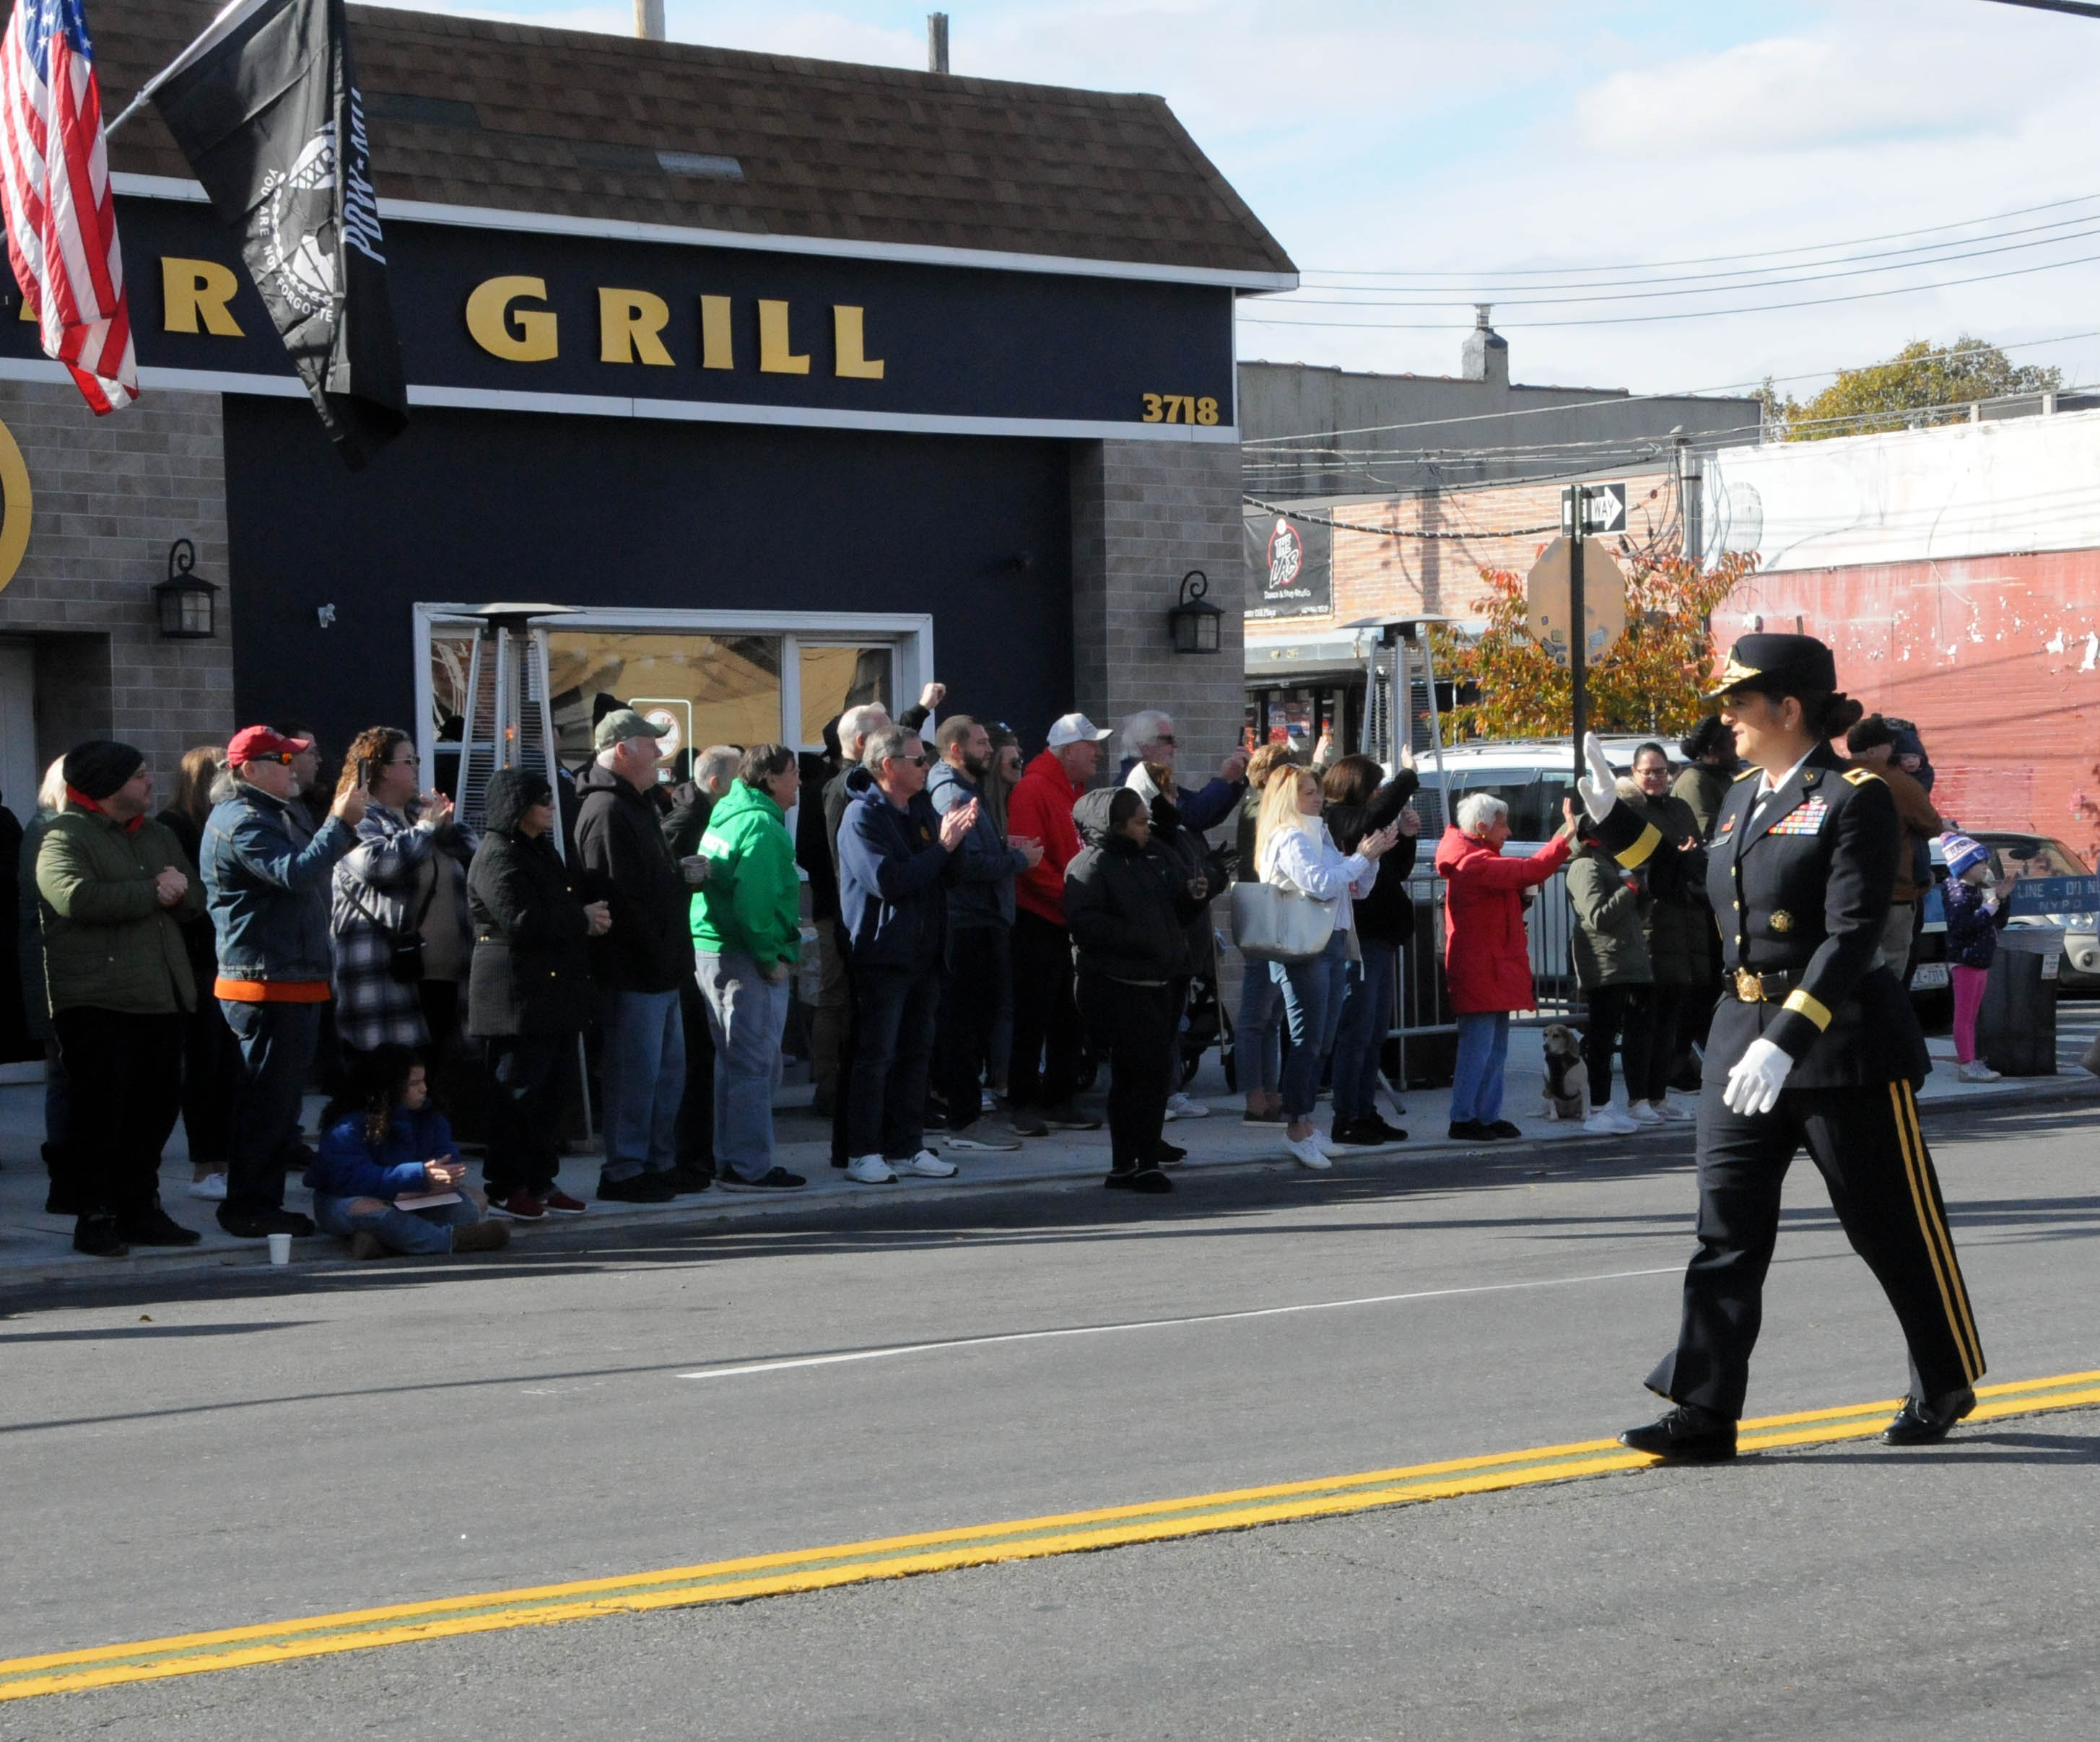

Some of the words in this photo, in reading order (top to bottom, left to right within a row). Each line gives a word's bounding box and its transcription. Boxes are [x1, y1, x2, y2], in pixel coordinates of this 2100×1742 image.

[259, 168, 279, 196] YOU
[259, 205, 270, 238] ARE
[341, 165, 386, 266] POW
[276, 276, 334, 323] FORGOTTE
[466, 274, 885, 379] GRILL
[1143, 393, 1219, 425] 3718
[1593, 498, 1615, 519] WAY
[1275, 533, 1291, 558] THE
[1269, 549, 1299, 589] LAB
[2017, 883, 2045, 899] LINE
